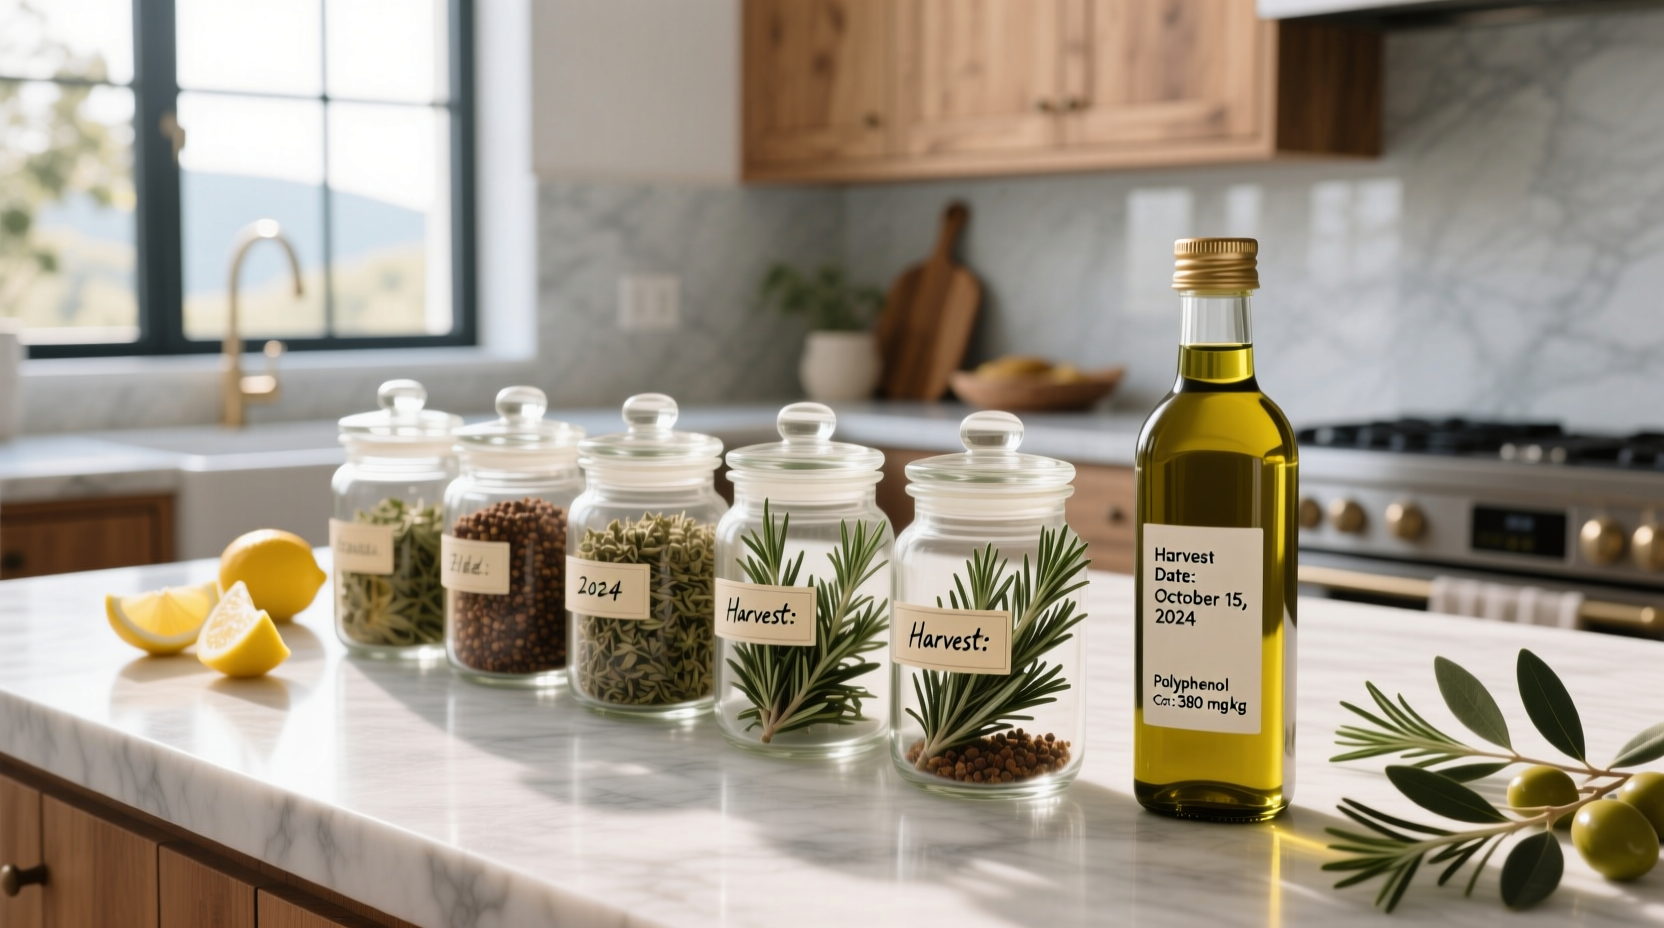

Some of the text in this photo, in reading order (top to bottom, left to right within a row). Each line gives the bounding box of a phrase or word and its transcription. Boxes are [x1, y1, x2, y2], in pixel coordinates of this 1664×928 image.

[1154, 547, 1215, 564] Harvest
[1154, 567, 1196, 583] Date:
[577, 576, 622, 601] 2024
[1154, 588, 1248, 611] October 15,
[726, 596, 797, 625] Harvest:
[1155, 608, 1196, 626] 2024
[909, 621, 990, 652] Harvest:
[1154, 674, 1229, 694] Polyphenol
[1177, 695, 1203, 709] 380
